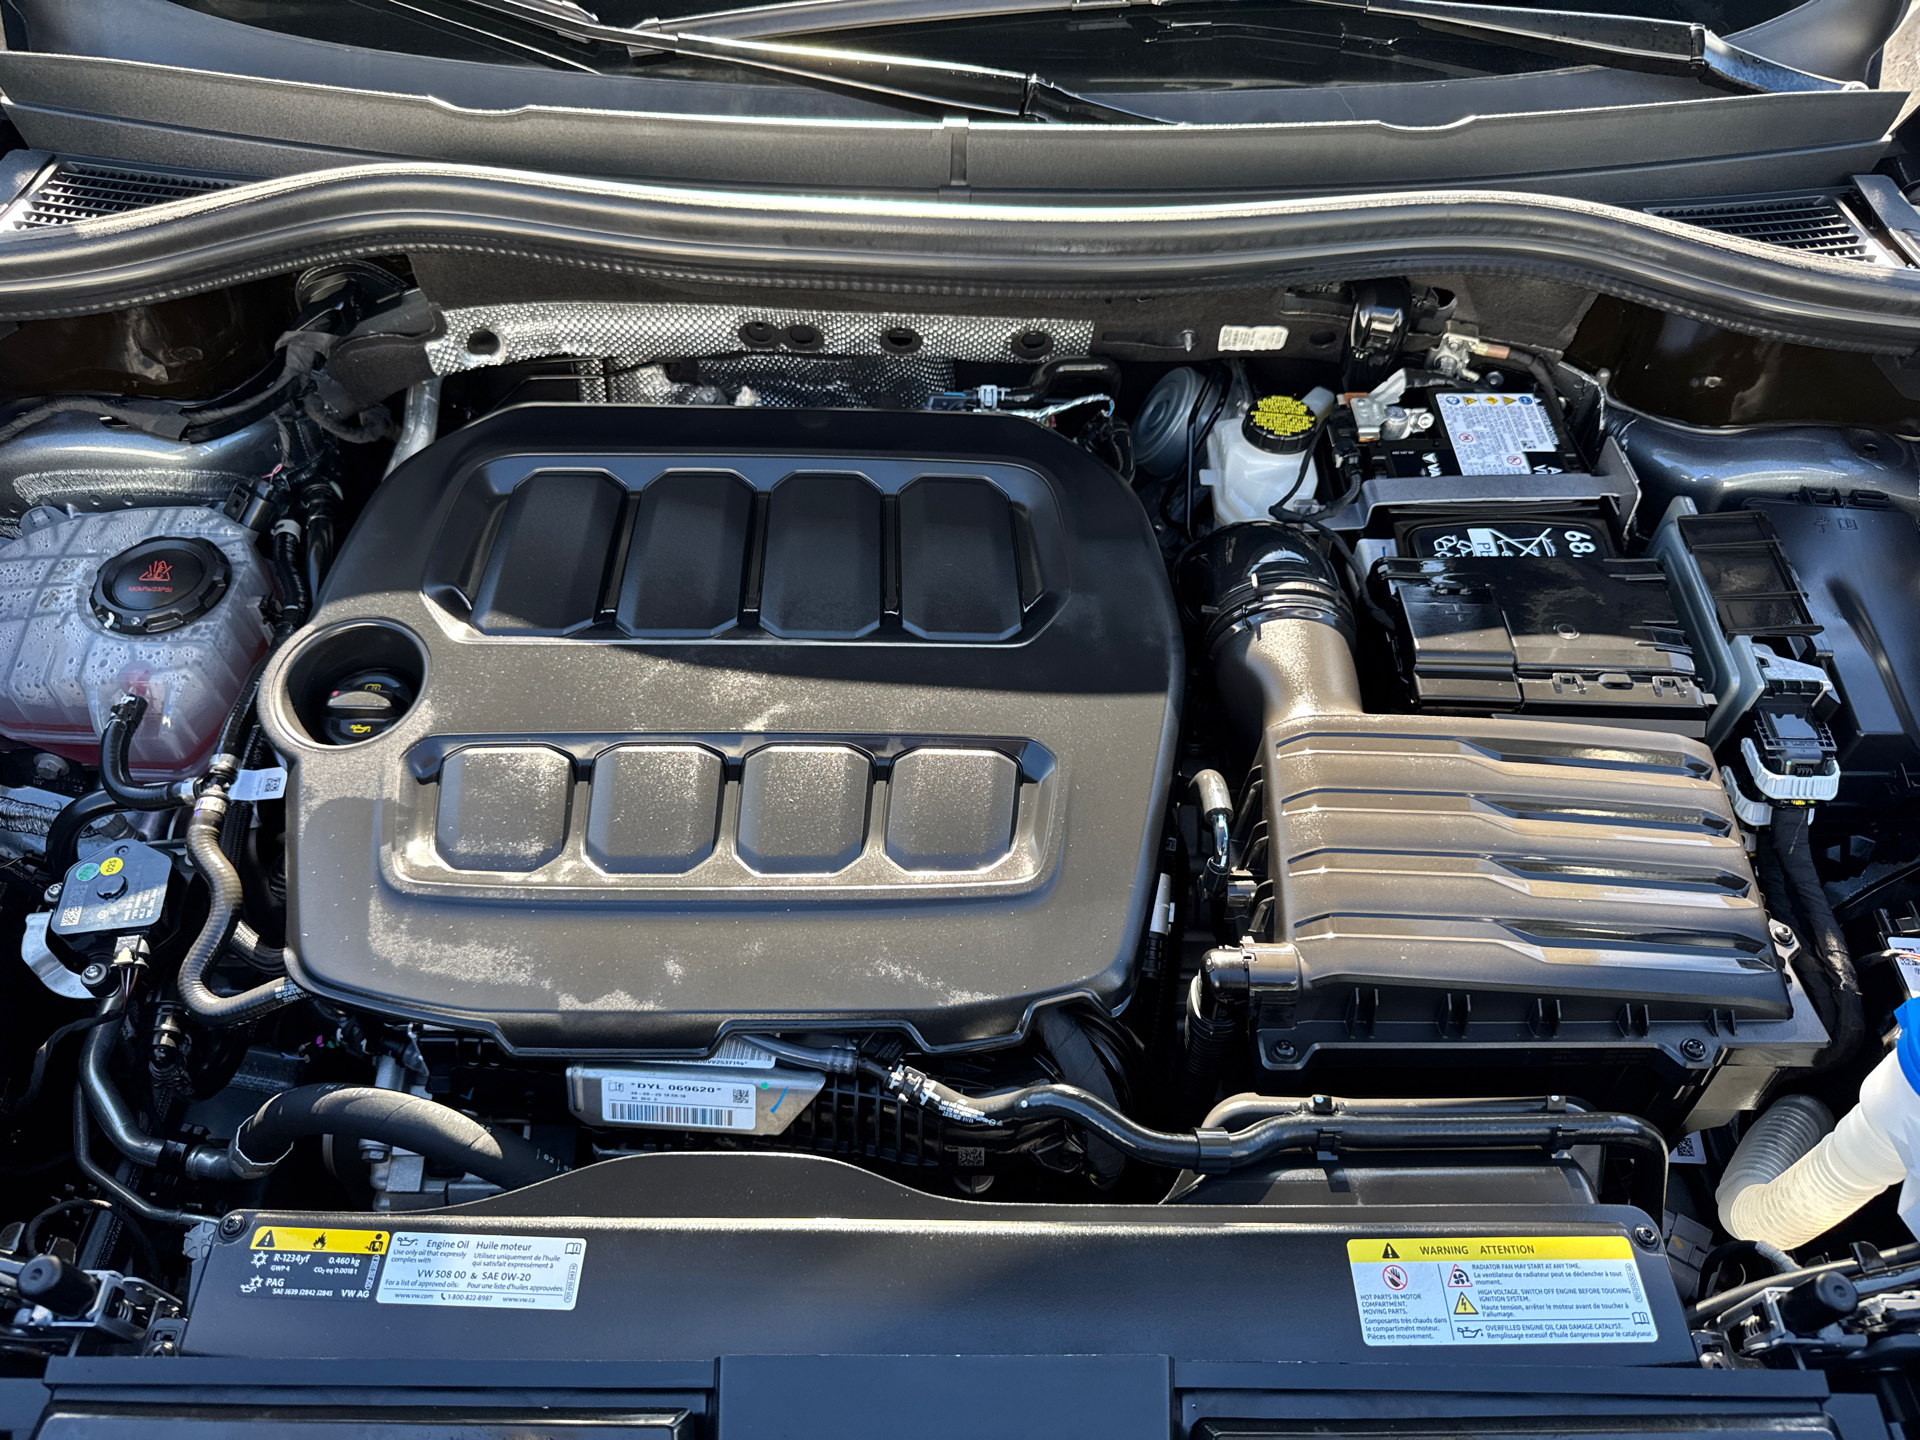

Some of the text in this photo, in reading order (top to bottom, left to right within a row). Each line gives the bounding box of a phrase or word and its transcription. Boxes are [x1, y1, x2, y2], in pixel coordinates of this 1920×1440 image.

[427, 1240, 456, 1250] Engine
[457, 1240, 469, 1249] Oil
[476, 1242, 499, 1250] Huile
[1420, 1245, 1535, 1255] WARNING ATTENTION
[273, 1254, 311, 1265] R-1234yf
[351, 1257, 360, 1267] kg
[507, 1261, 549, 1269] expressément
[418, 1269, 434, 1278] VW
[435, 1270, 452, 1278] 508
[482, 1272, 499, 1280] SAE
[501, 1272, 531, 1281] 0W-20
[265, 1278, 285, 1287] PAG
[357, 1290, 370, 1298] AG
